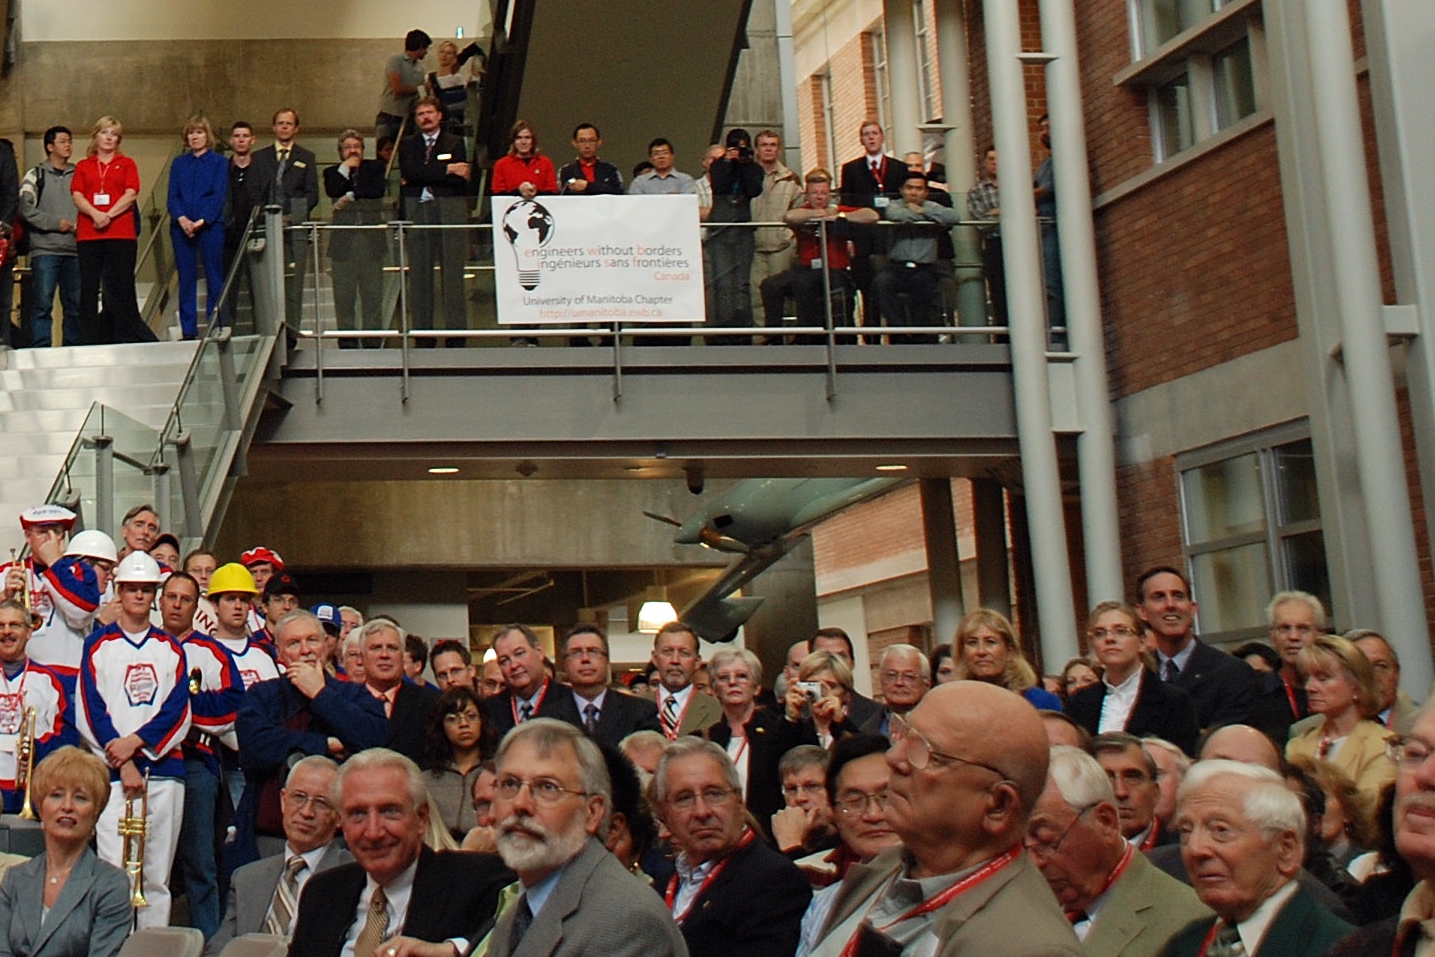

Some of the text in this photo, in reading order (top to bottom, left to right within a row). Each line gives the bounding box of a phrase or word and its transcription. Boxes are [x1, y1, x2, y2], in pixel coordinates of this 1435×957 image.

[524, 245, 683, 259] engineers without borders
[536, 256, 689, 272] ingénieurs sans frontières
[653, 271, 691, 281] Canada
[523, 294, 674, 307] University of Manitoba Chapter
